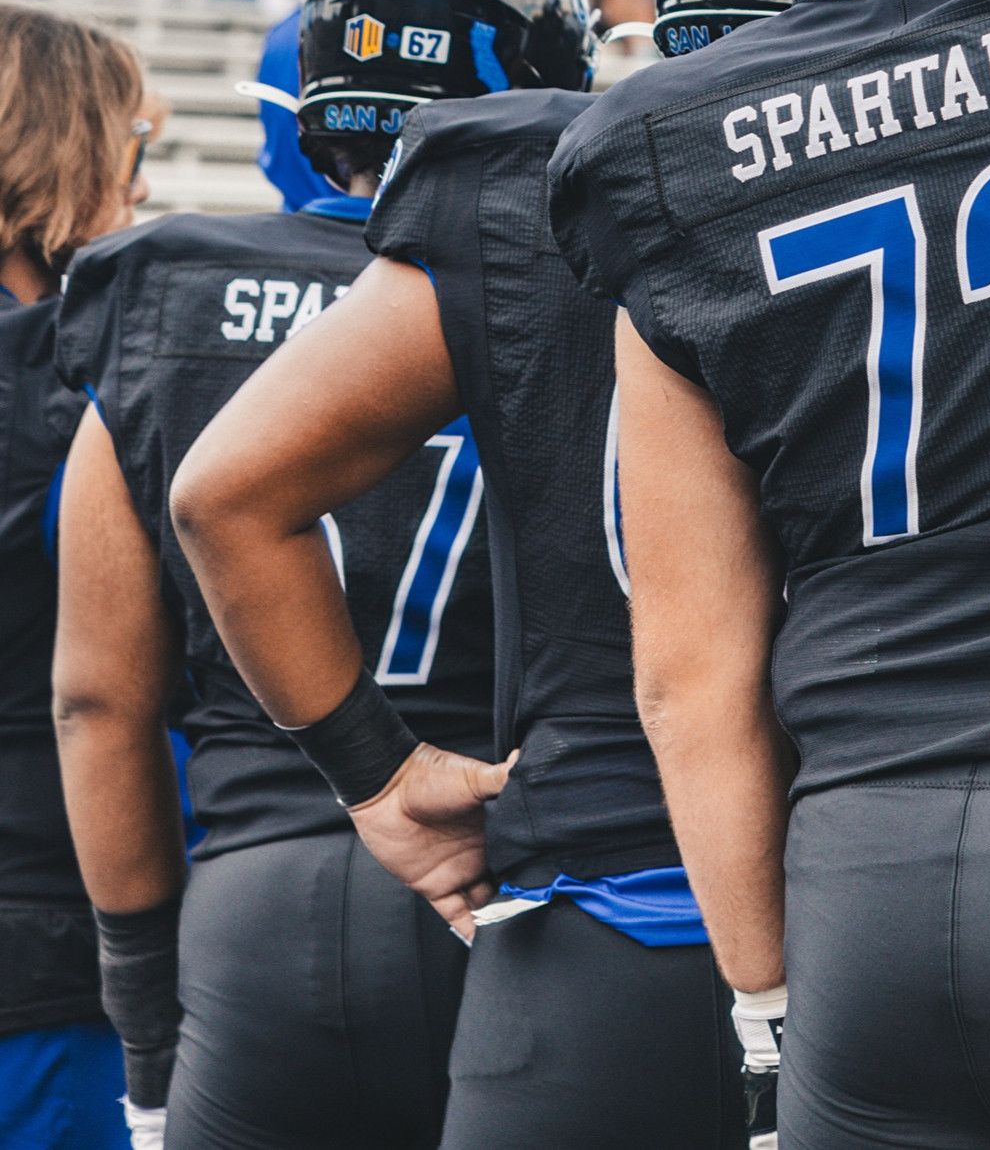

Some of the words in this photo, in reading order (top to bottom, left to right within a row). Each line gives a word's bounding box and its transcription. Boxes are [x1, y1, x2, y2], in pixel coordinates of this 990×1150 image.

[408, 31, 443, 59] 67
[666, 25, 711, 54] SAN
[325, 104, 377, 132] SAN
[221, 278, 351, 342] SPA
[319, 413, 484, 686] 7
